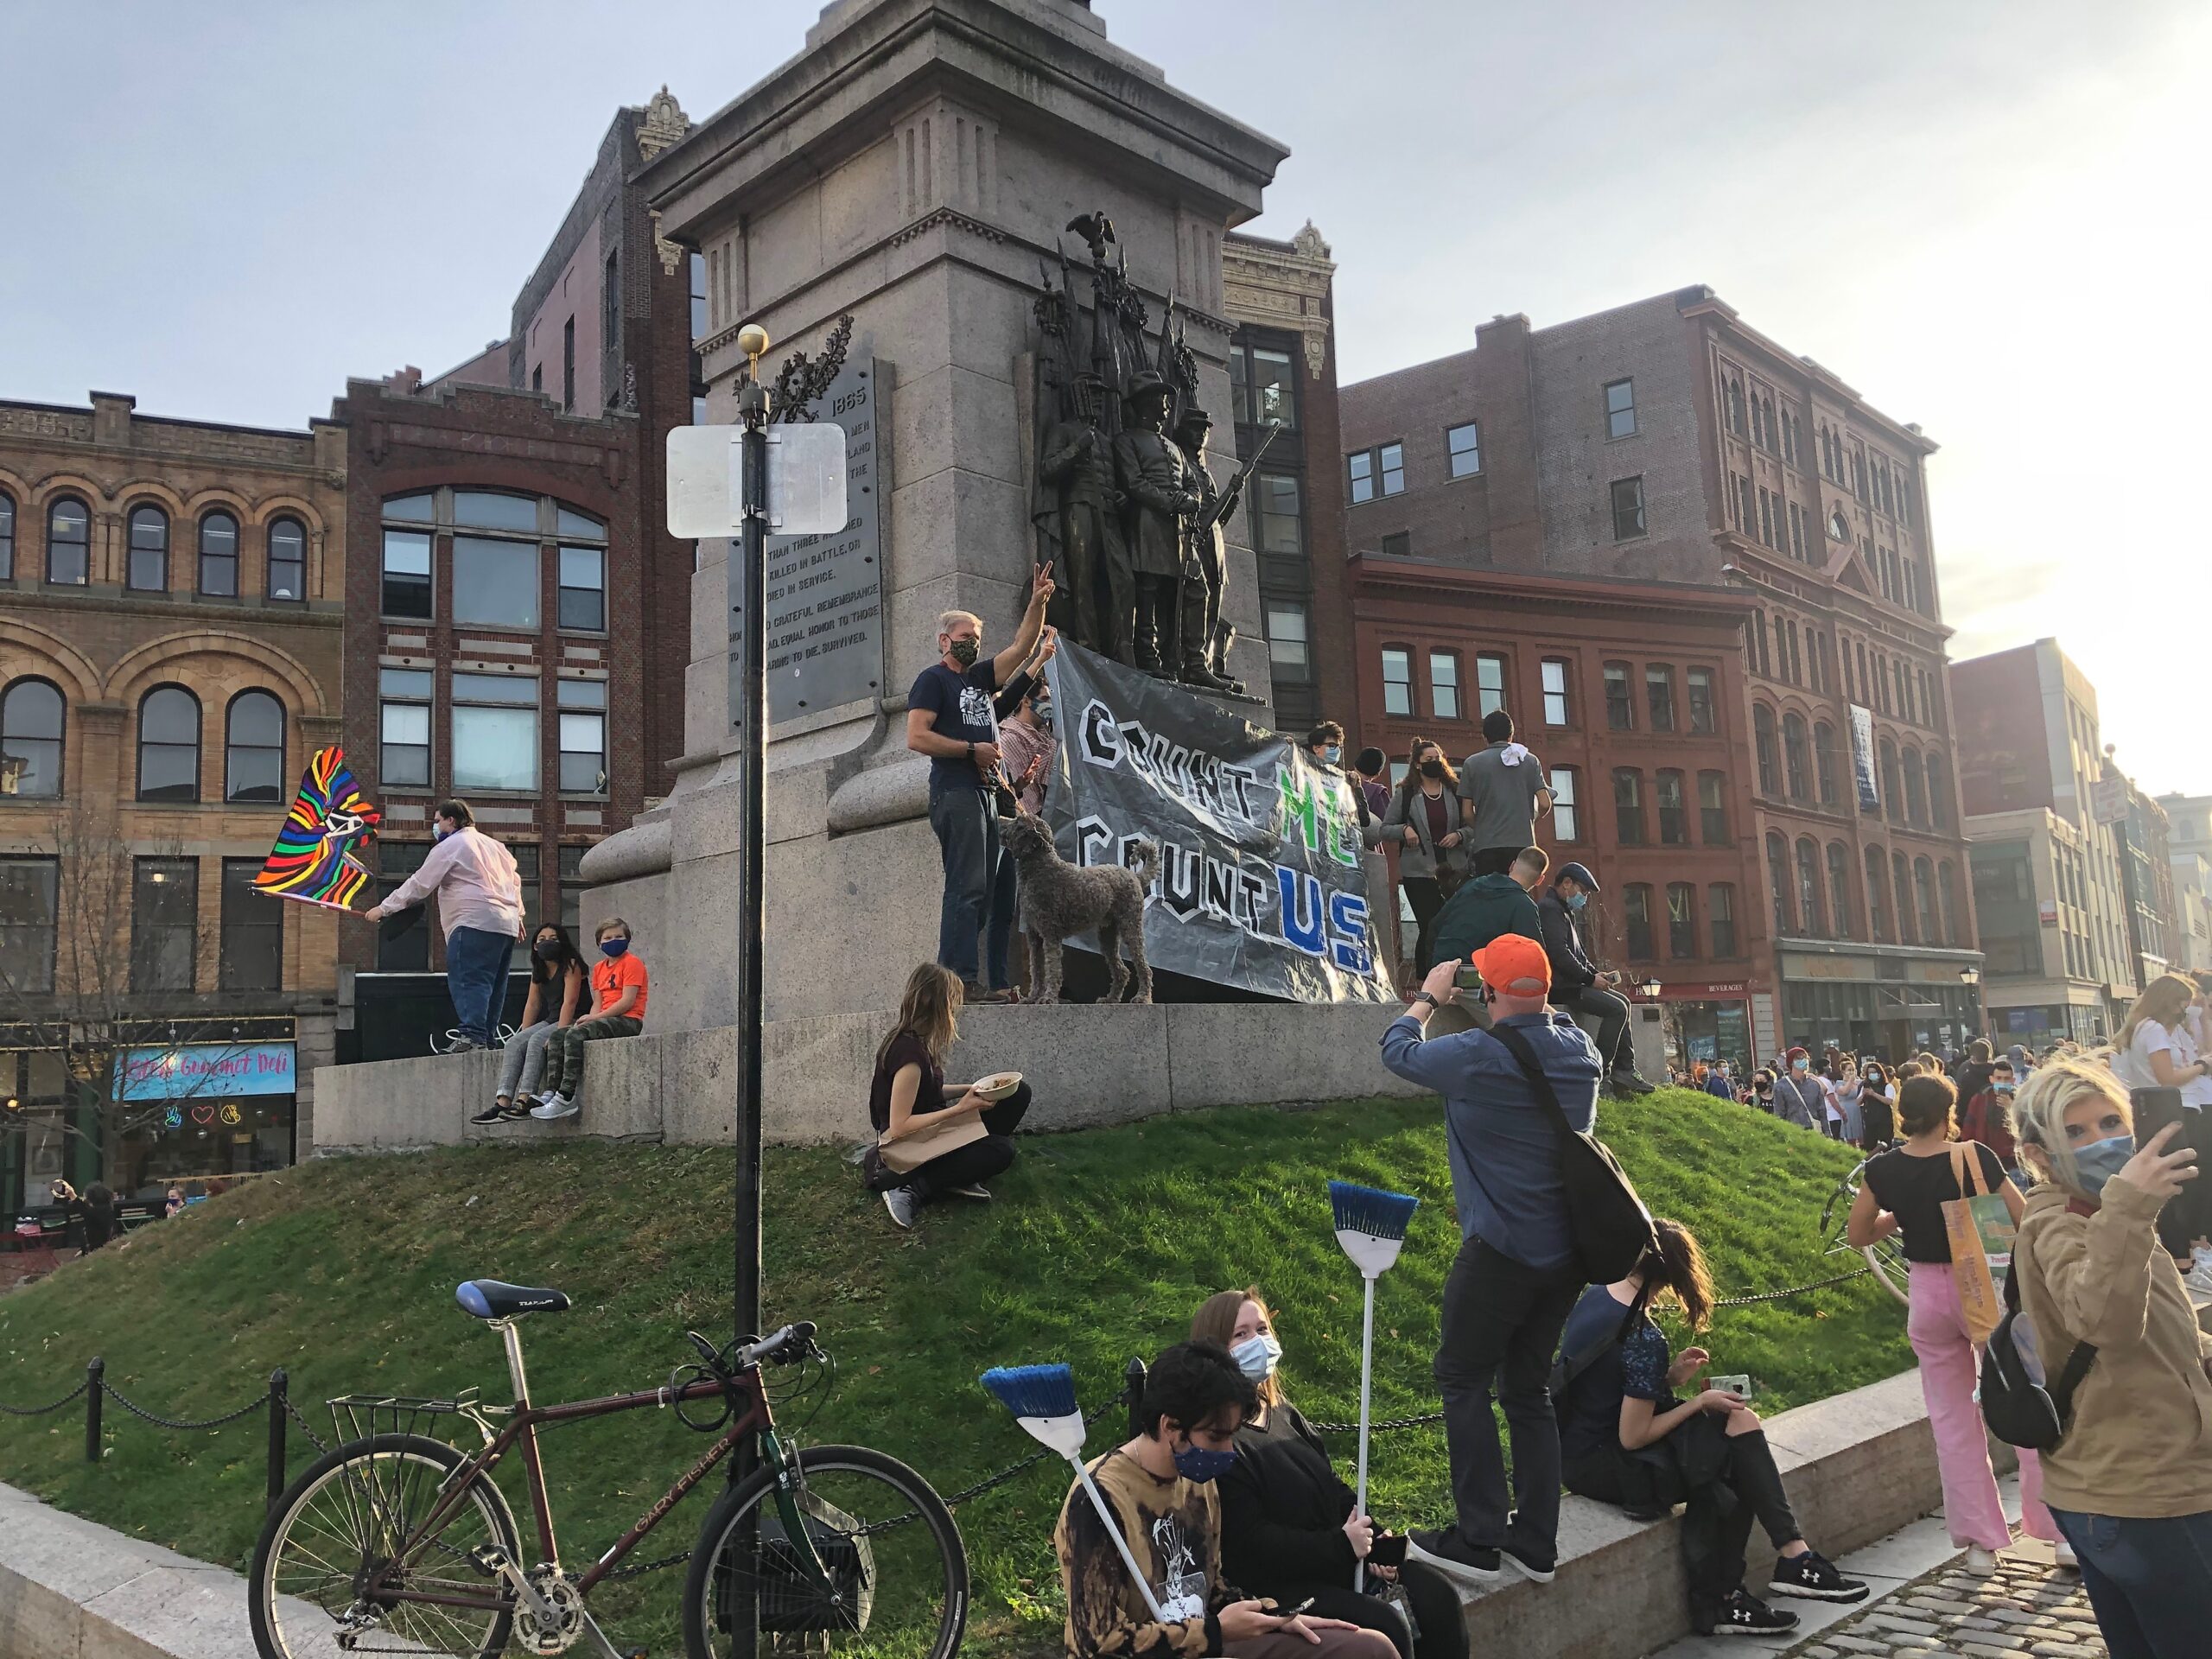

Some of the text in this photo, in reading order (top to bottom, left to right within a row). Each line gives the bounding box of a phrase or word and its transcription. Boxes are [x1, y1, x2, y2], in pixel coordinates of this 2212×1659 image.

[833, 386, 867, 416] 1865
[851, 420, 870, 436] MEN
[849, 463, 868, 479] THE
[768, 533, 820, 562] THAN THREE
[769, 563, 797, 582] KILLED
[800, 558, 808, 570] IN
[767, 569, 836, 602] DIED IN SERVICE.
[774, 582, 879, 628] GRATEFUL REMEMBRANCE
[729, 652, 739, 663] TO
[780, 629, 804, 646] EQUAL
[809, 620, 835, 637] HONOR
[838, 615, 849, 627] TO
[851, 604, 880, 623] THOSE
[767, 656, 789, 671] ARING
[792, 652, 803, 663] TO
[1077, 698, 1360, 869] COUNT ME
[1275, 864, 1373, 977] US
[1708, 984, 1743, 993] BEVERAGES
[180, 1053, 253, 1077] Gourmet
[257, 1050, 288, 1074] Deli
[635, 1438, 732, 1532] GARY FISHER
